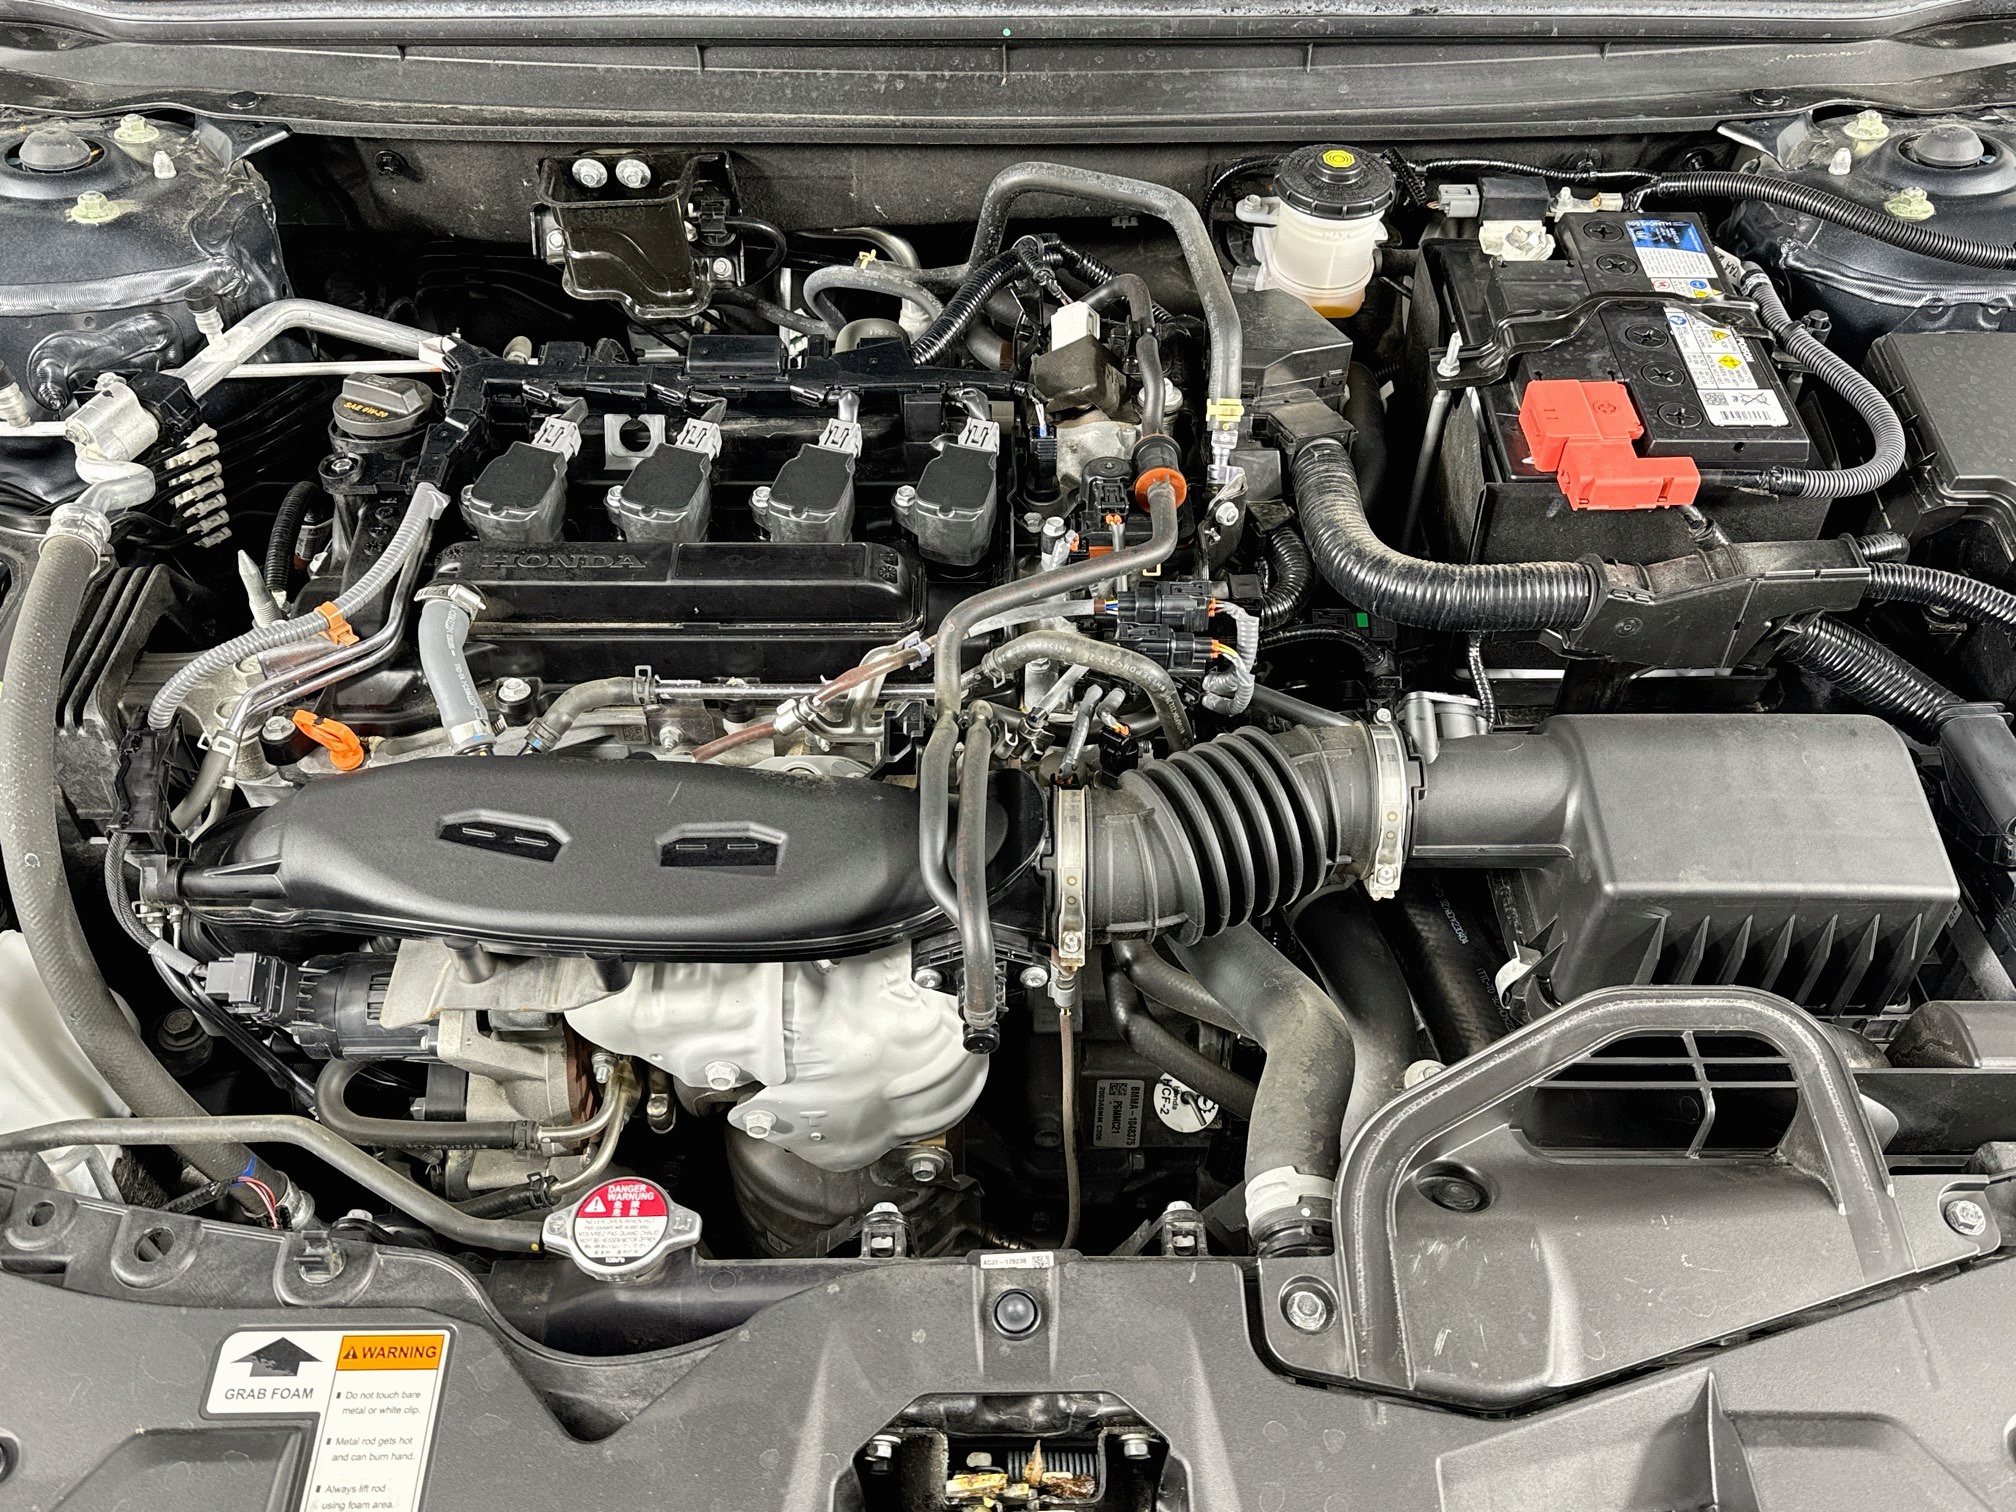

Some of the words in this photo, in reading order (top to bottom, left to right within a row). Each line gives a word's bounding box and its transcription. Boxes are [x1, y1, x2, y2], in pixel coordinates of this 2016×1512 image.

[1324, 231, 1350, 240] MAX
[343, 401, 362, 411] SAE
[481, 554, 647, 569] HONDA
[1160, 1078, 1173, 1115] HCF-2
[608, 1184, 647, 1193] DANGER
[608, 1192, 655, 1201] WARNUNG
[362, 1345, 438, 1359] WARNING
[224, 1387, 267, 1400] GRAB
[270, 1387, 314, 1400] FOAM
[345, 1391, 358, 1399] Do
[360, 1391, 374, 1399] not
[376, 1391, 399, 1399] touch
[401, 1390, 421, 1399] bare
[342, 1406, 366, 1414] metal
[379, 1405, 401, 1414] white
[403, 1405, 421, 1415] clip.
[335, 1437, 360, 1445] Metal
[361, 1437, 376, 1445] rod
[378, 1437, 396, 1447] gets
[398, 1436, 413, 1445] hot
[332, 1452, 349, 1461] and
[369, 1452, 388, 1461] burn
[391, 1452, 415, 1461] hand.
[325, 1485, 357, 1495] Always
[359, 1484, 369, 1493] lift
[371, 1484, 386, 1493] rod
[321, 1501, 346, 1511] using
[348, 1500, 370, 1509] foam
[372, 1501, 394, 1509] area.
